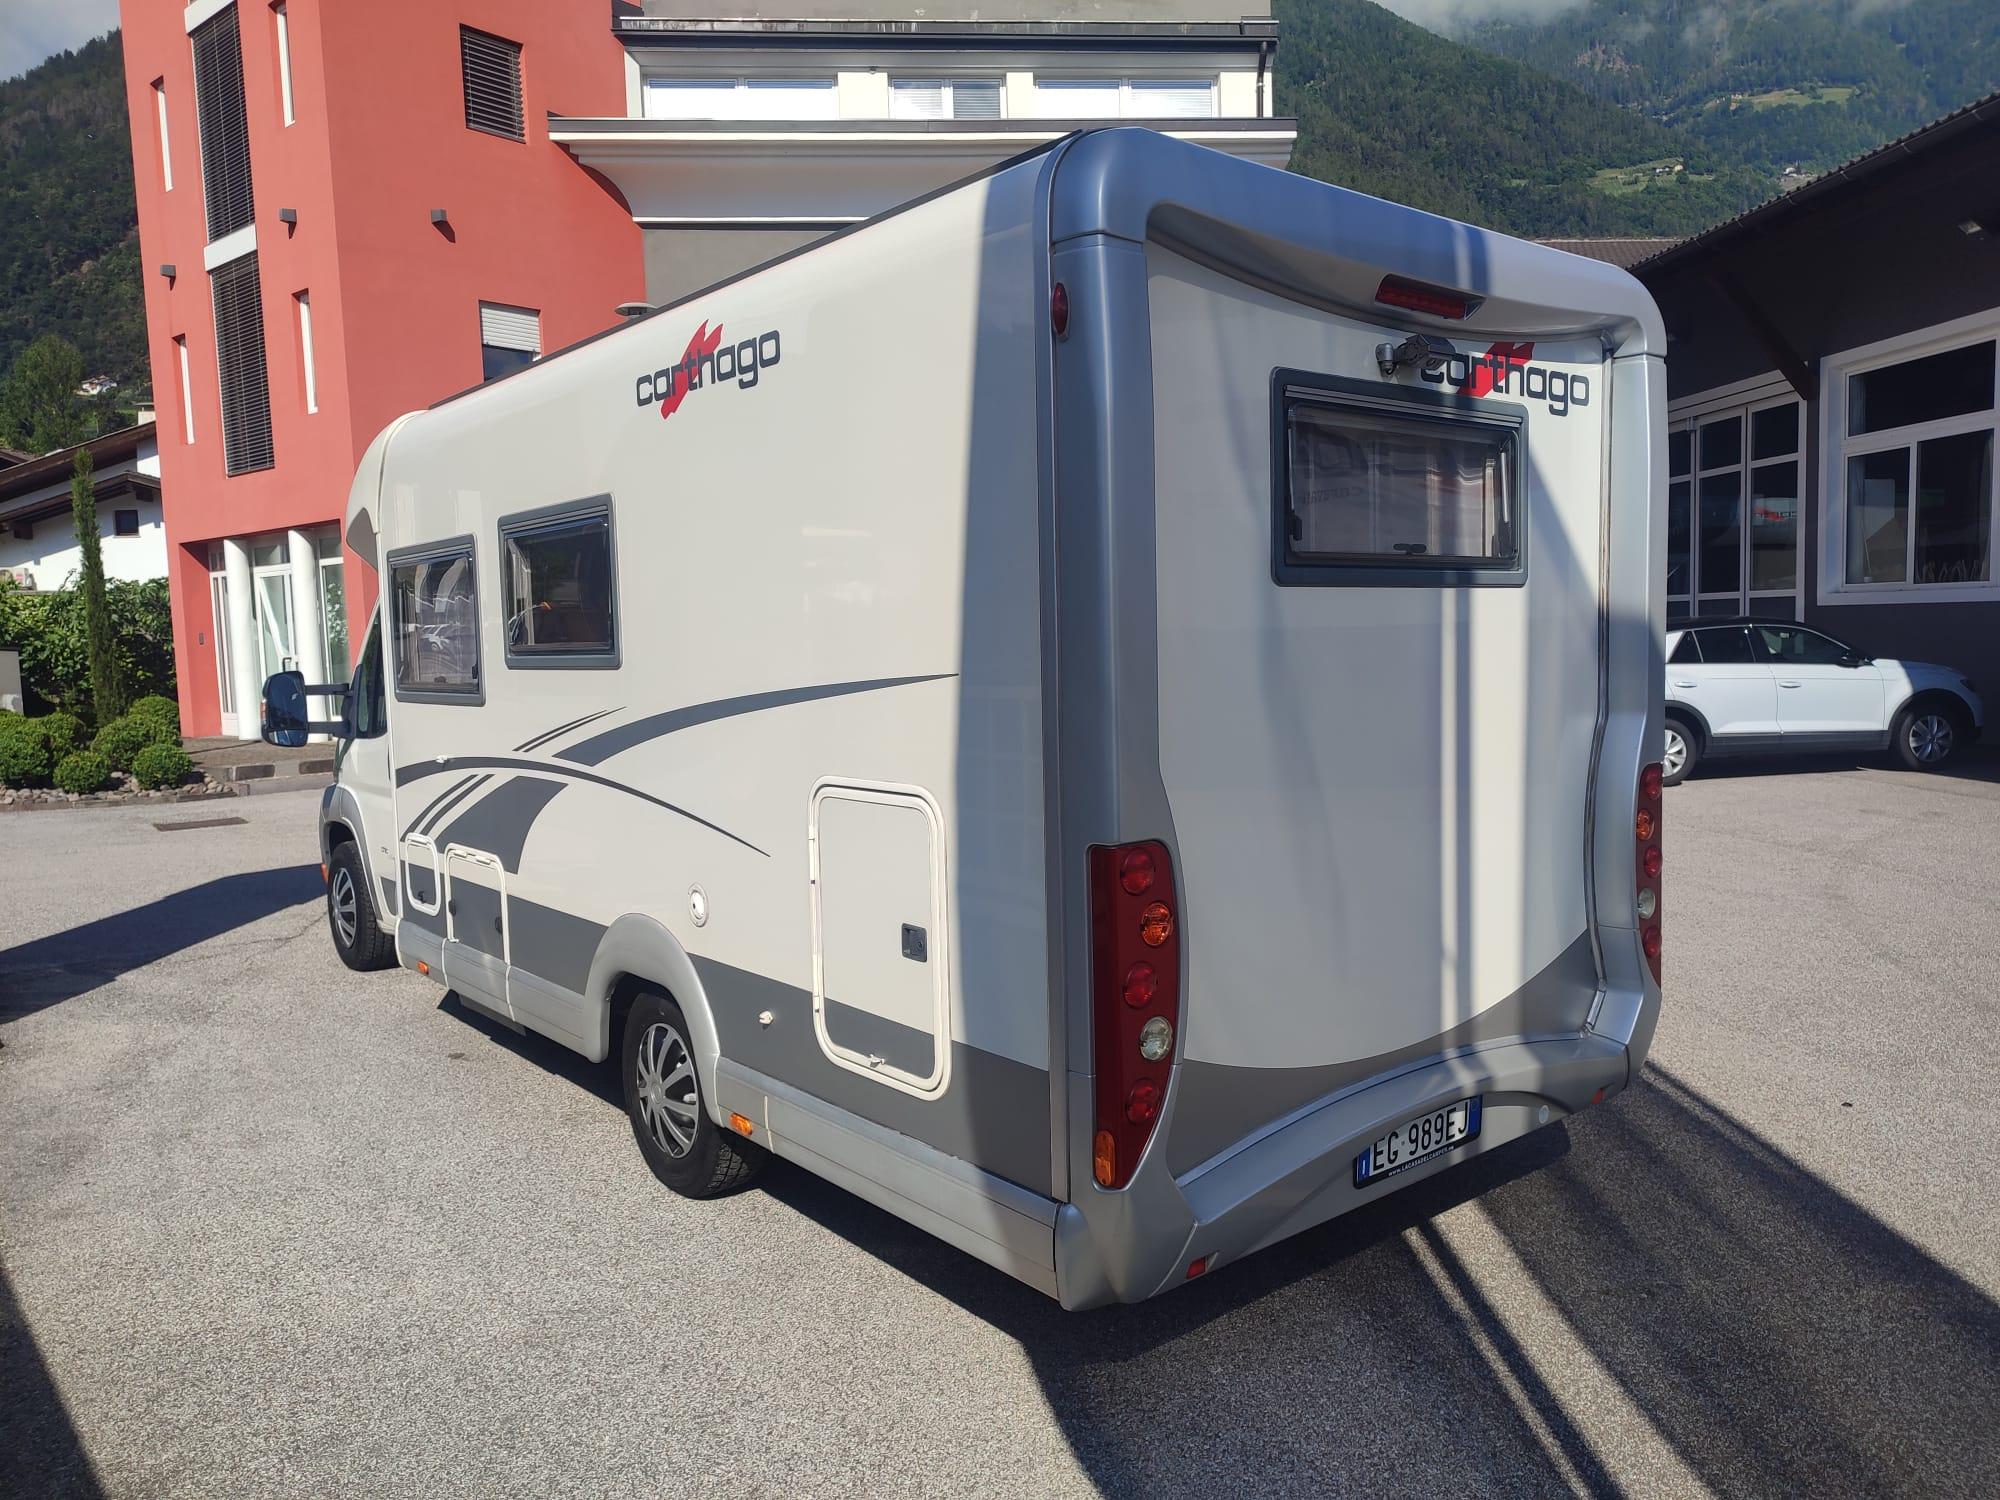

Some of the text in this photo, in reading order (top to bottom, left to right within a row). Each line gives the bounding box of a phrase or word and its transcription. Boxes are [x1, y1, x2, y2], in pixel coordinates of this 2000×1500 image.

[637, 330, 780, 407] carthago
[1373, 1131, 1399, 1171] EG
[1408, 1101, 1468, 1156] 989EJ
